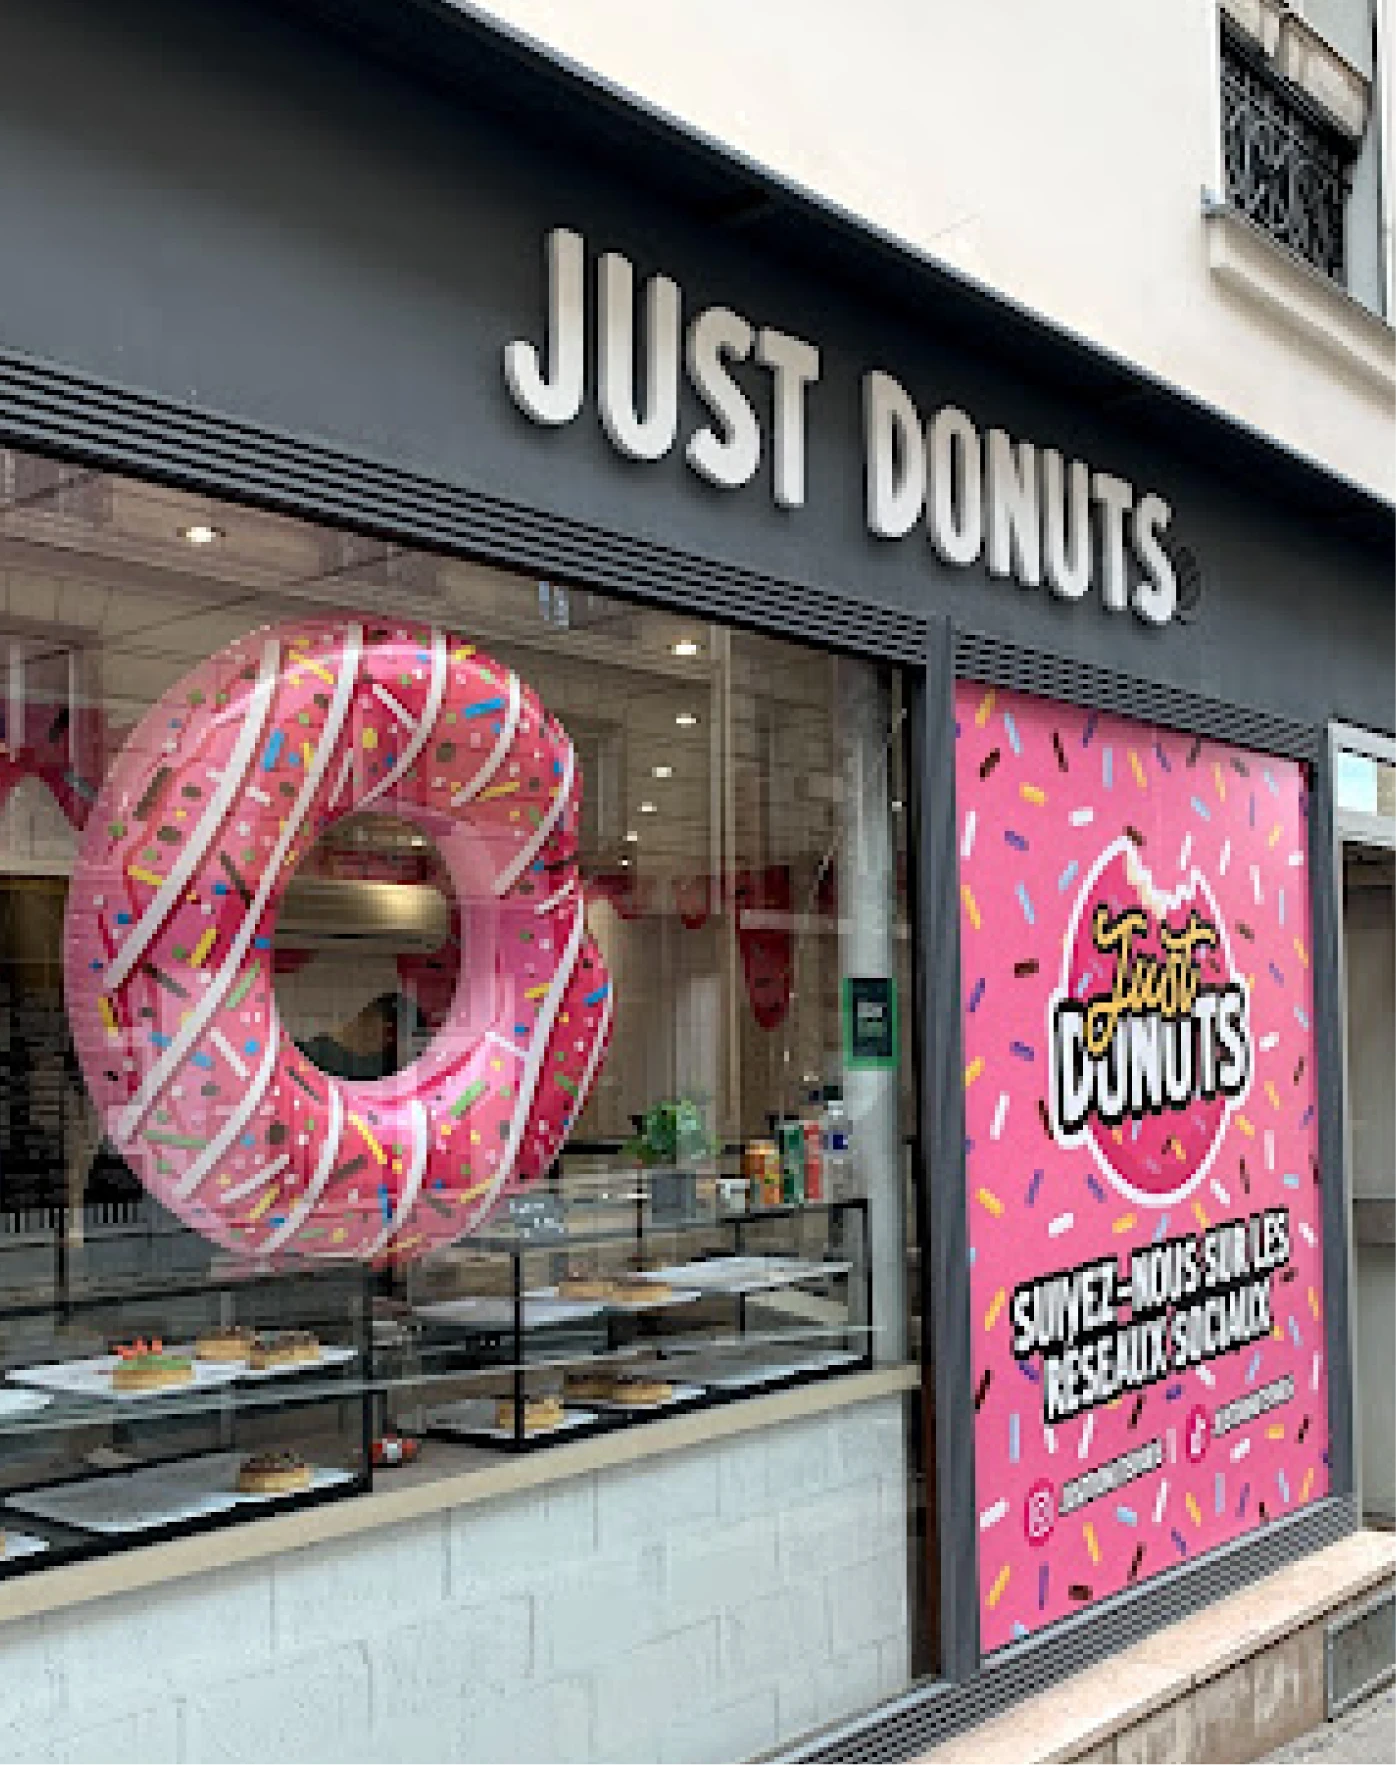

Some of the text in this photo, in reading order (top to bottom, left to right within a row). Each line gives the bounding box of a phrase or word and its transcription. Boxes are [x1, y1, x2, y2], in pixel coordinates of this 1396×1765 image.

[503, 227, 1180, 624] JUST DONUTS
[1087, 902, 1220, 1060] Just
[1054, 983, 1250, 1134] DONUTS
[1011, 1208, 1290, 1358] SUIVEZ-NOUS SUR LES
[1170, 1281, 1271, 1368] SOCIAUX
